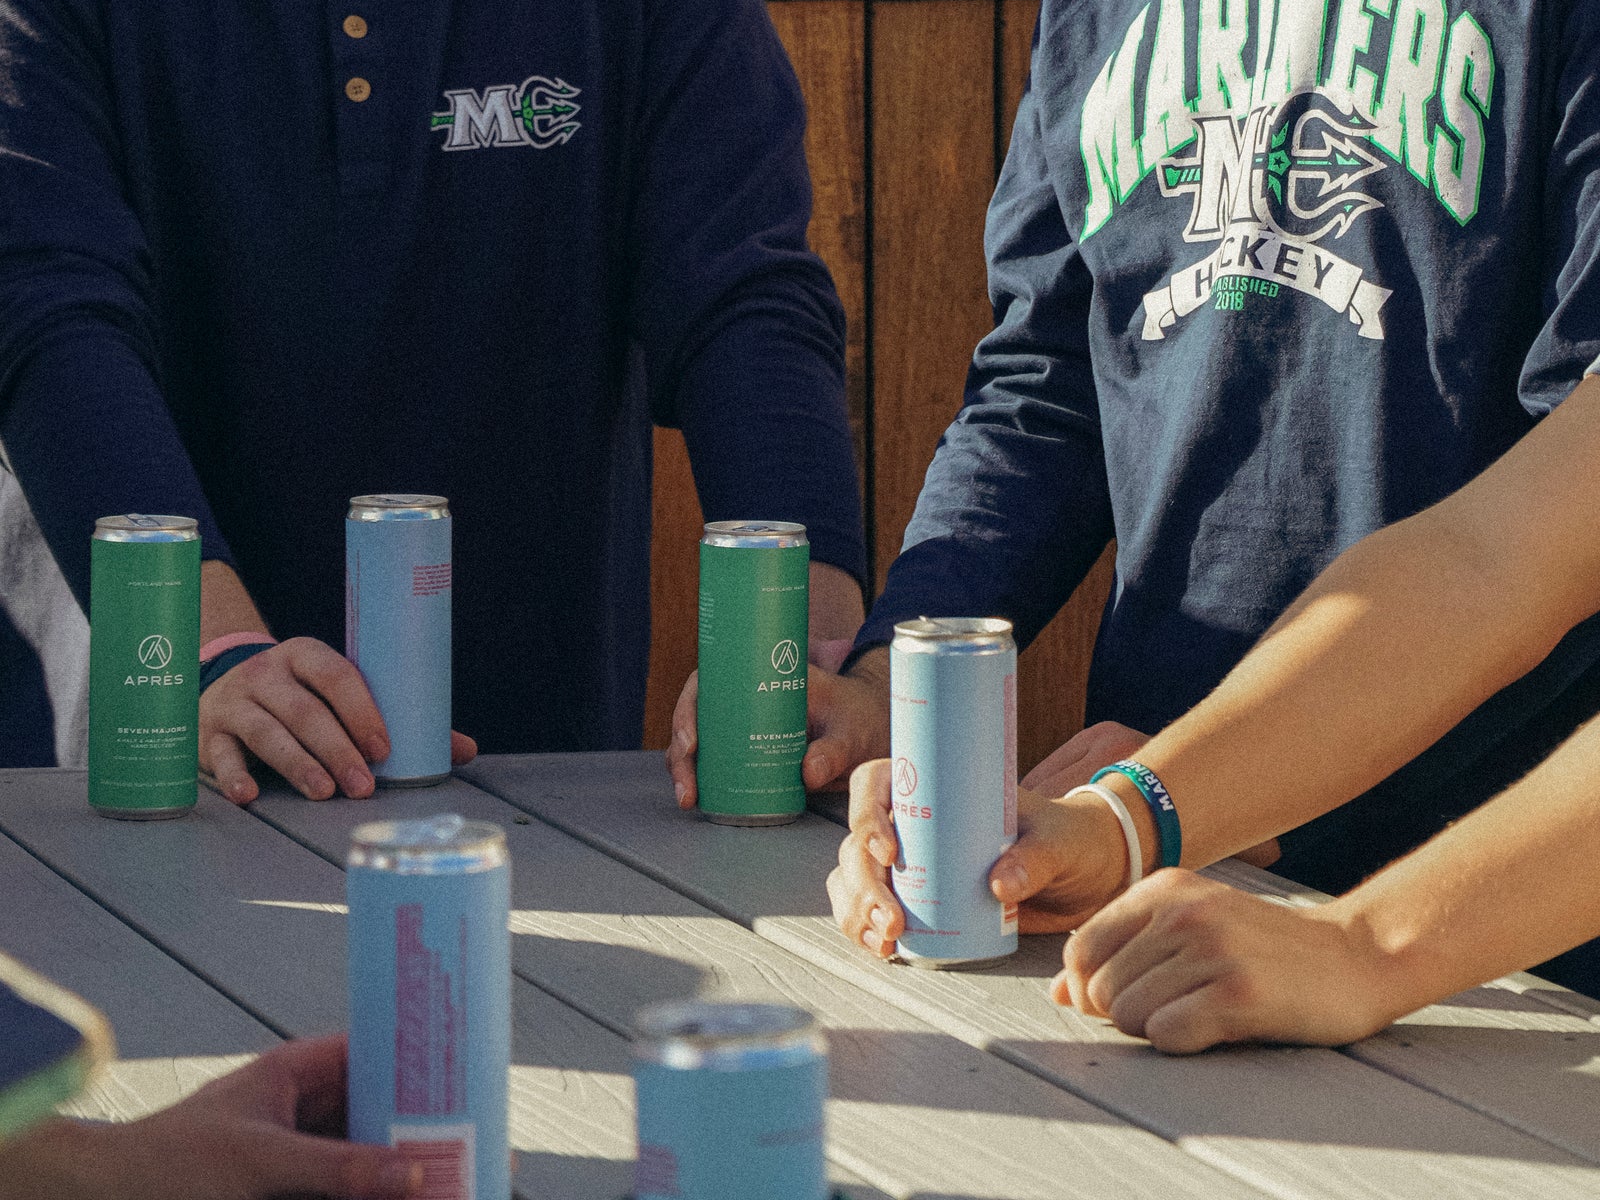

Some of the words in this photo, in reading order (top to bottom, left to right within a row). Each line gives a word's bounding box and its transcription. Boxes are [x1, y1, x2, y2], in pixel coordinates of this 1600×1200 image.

[1195, 235, 1334, 299] HCKEY
[1214, 291, 1244, 311] 2018
[117, 727, 149, 735] SEVEN
[151, 725, 187, 734] MAJORS
